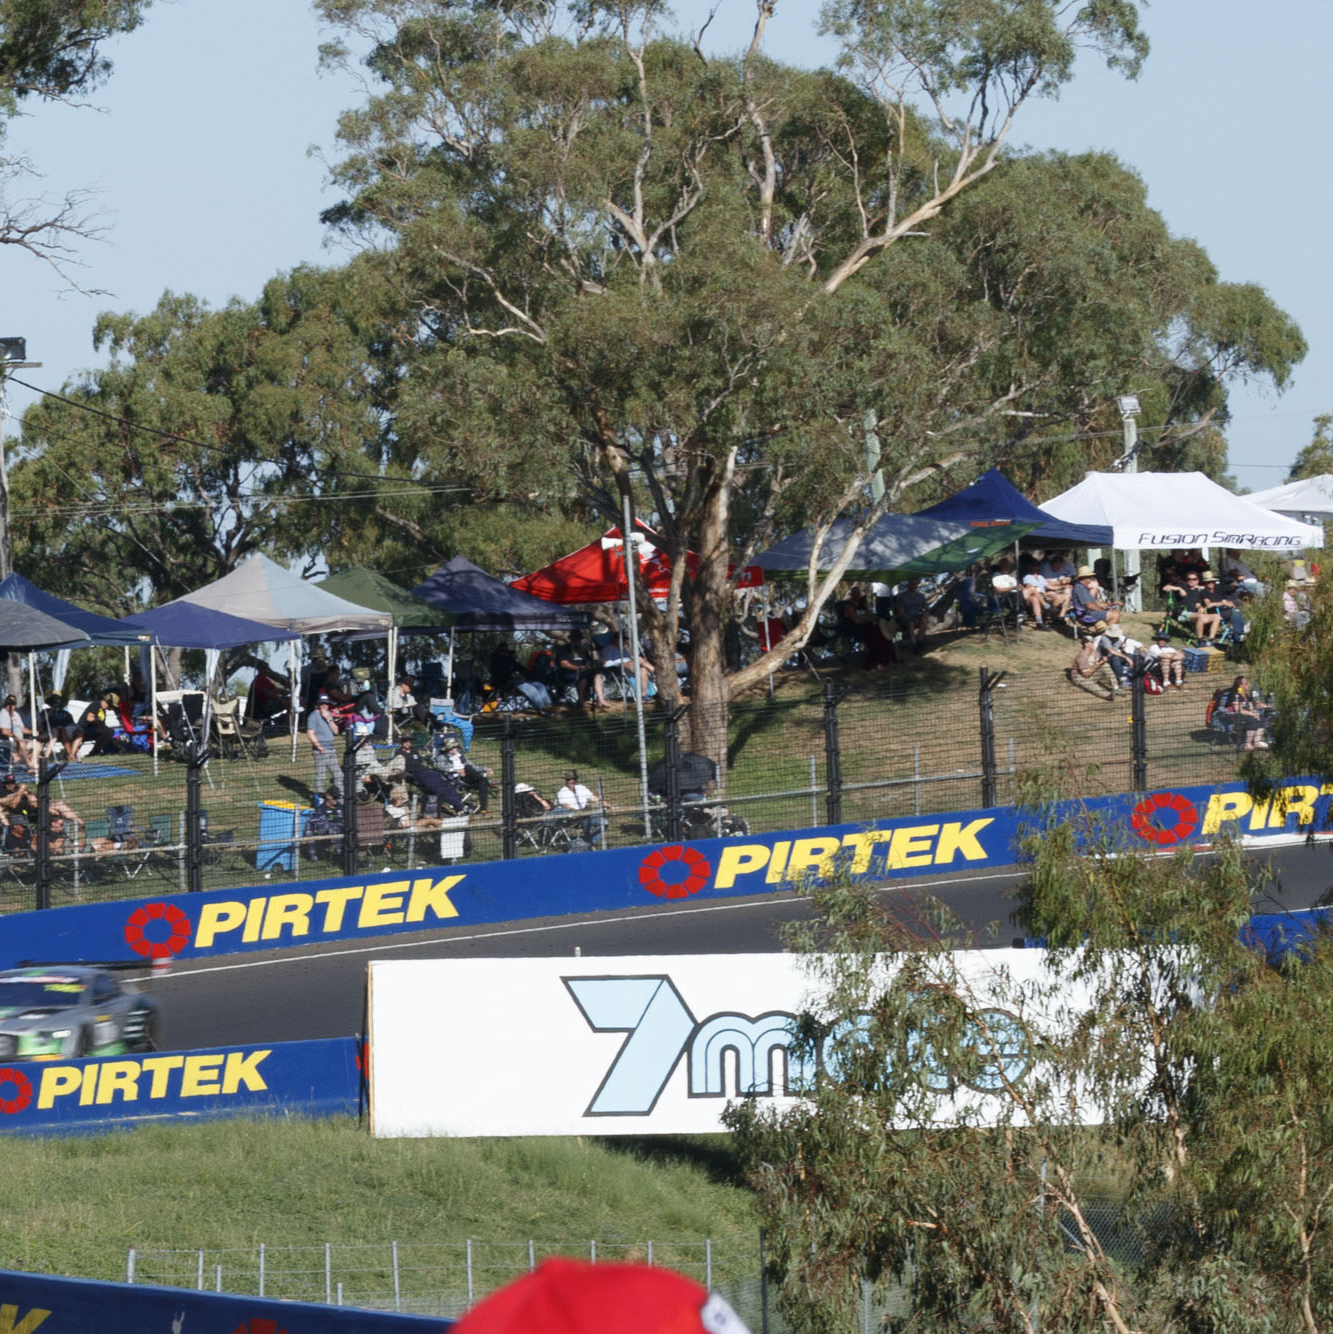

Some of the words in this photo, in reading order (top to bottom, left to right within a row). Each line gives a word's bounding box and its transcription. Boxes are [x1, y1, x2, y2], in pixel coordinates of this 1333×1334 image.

[714, 817, 995, 889] PIRTEK
[194, 874, 467, 948] PIRTEK
[37, 1049, 272, 1109] PIRTEK
